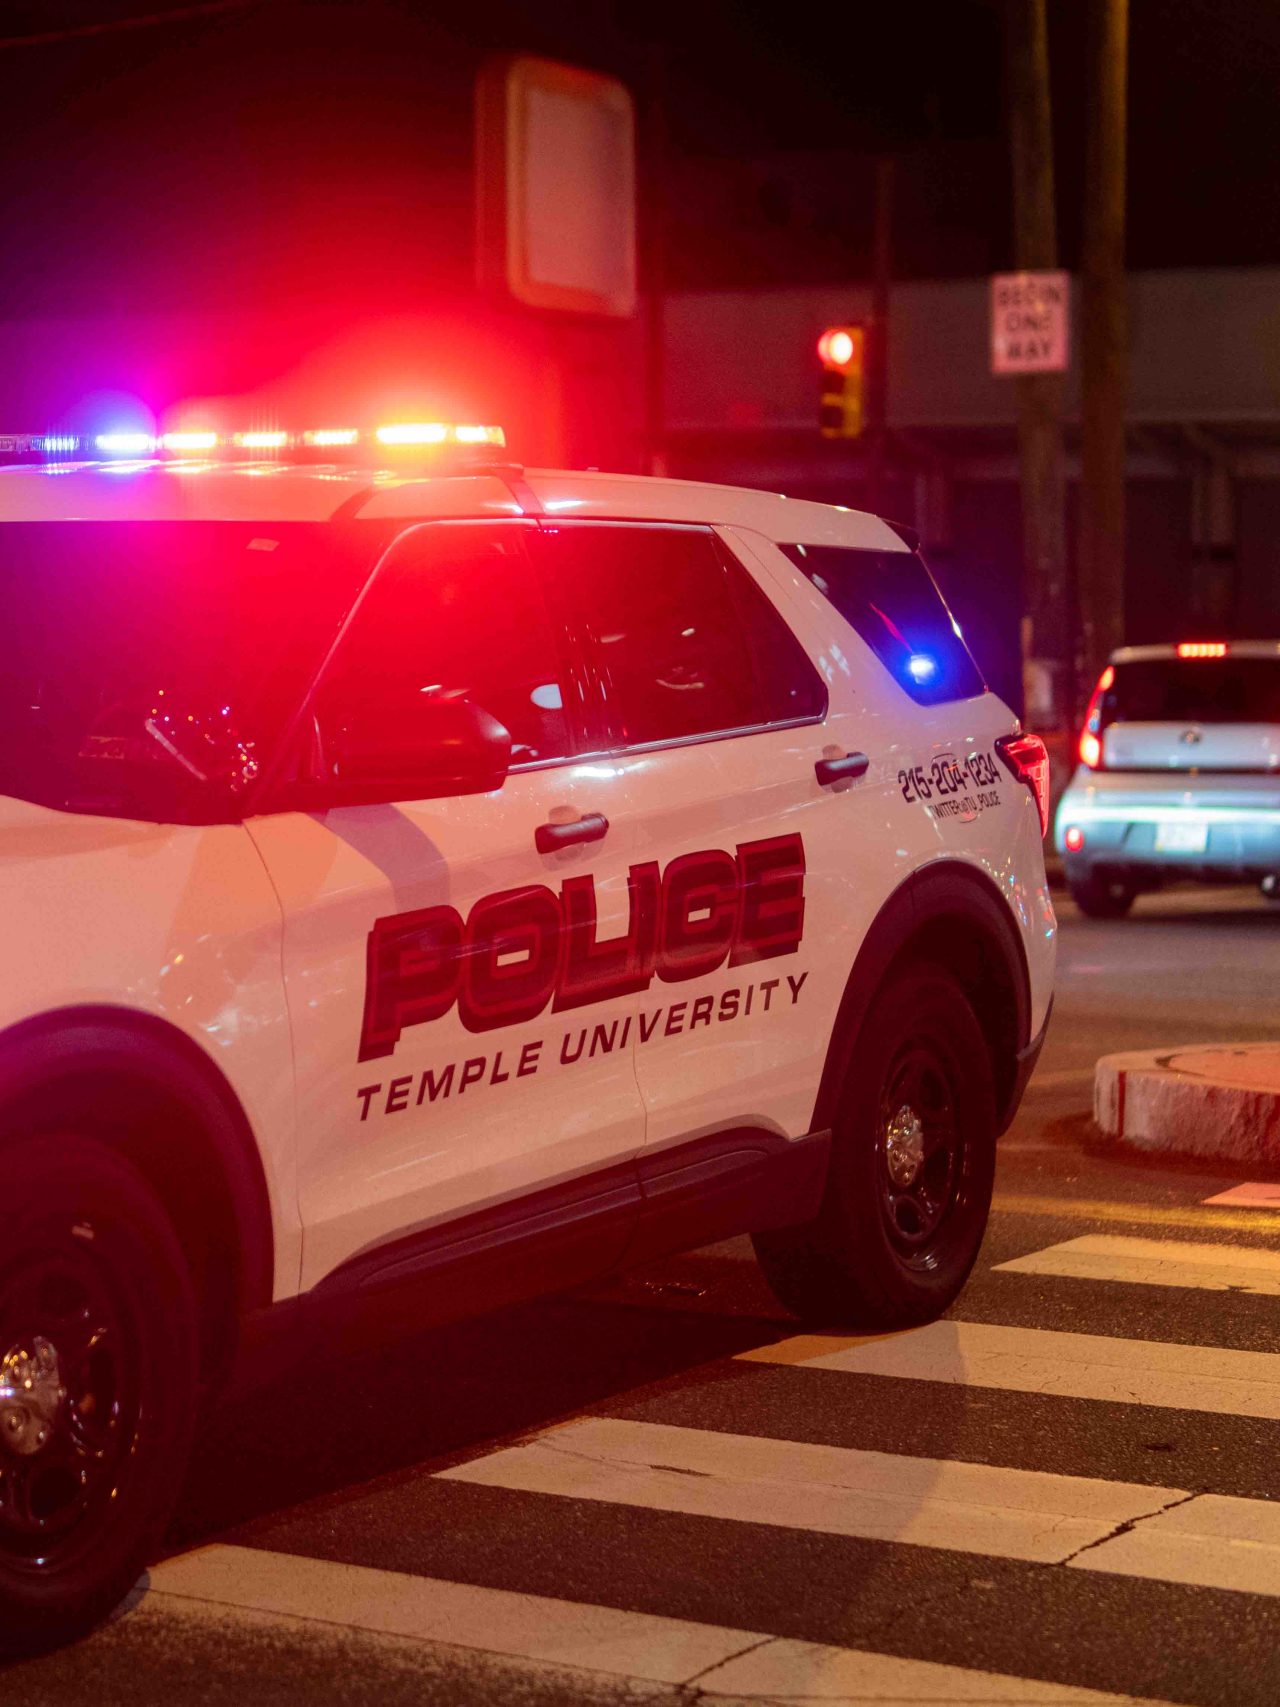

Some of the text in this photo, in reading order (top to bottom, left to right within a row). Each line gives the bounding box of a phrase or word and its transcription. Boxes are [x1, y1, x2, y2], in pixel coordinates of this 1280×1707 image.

[1005, 311, 1053, 333] ONE
[1006, 340, 1056, 359] WAY
[897, 752, 1002, 803] 215-204-1234
[357, 832, 806, 1063] POLICE
[357, 971, 809, 1122] TEMPLE UNIVERSITY
